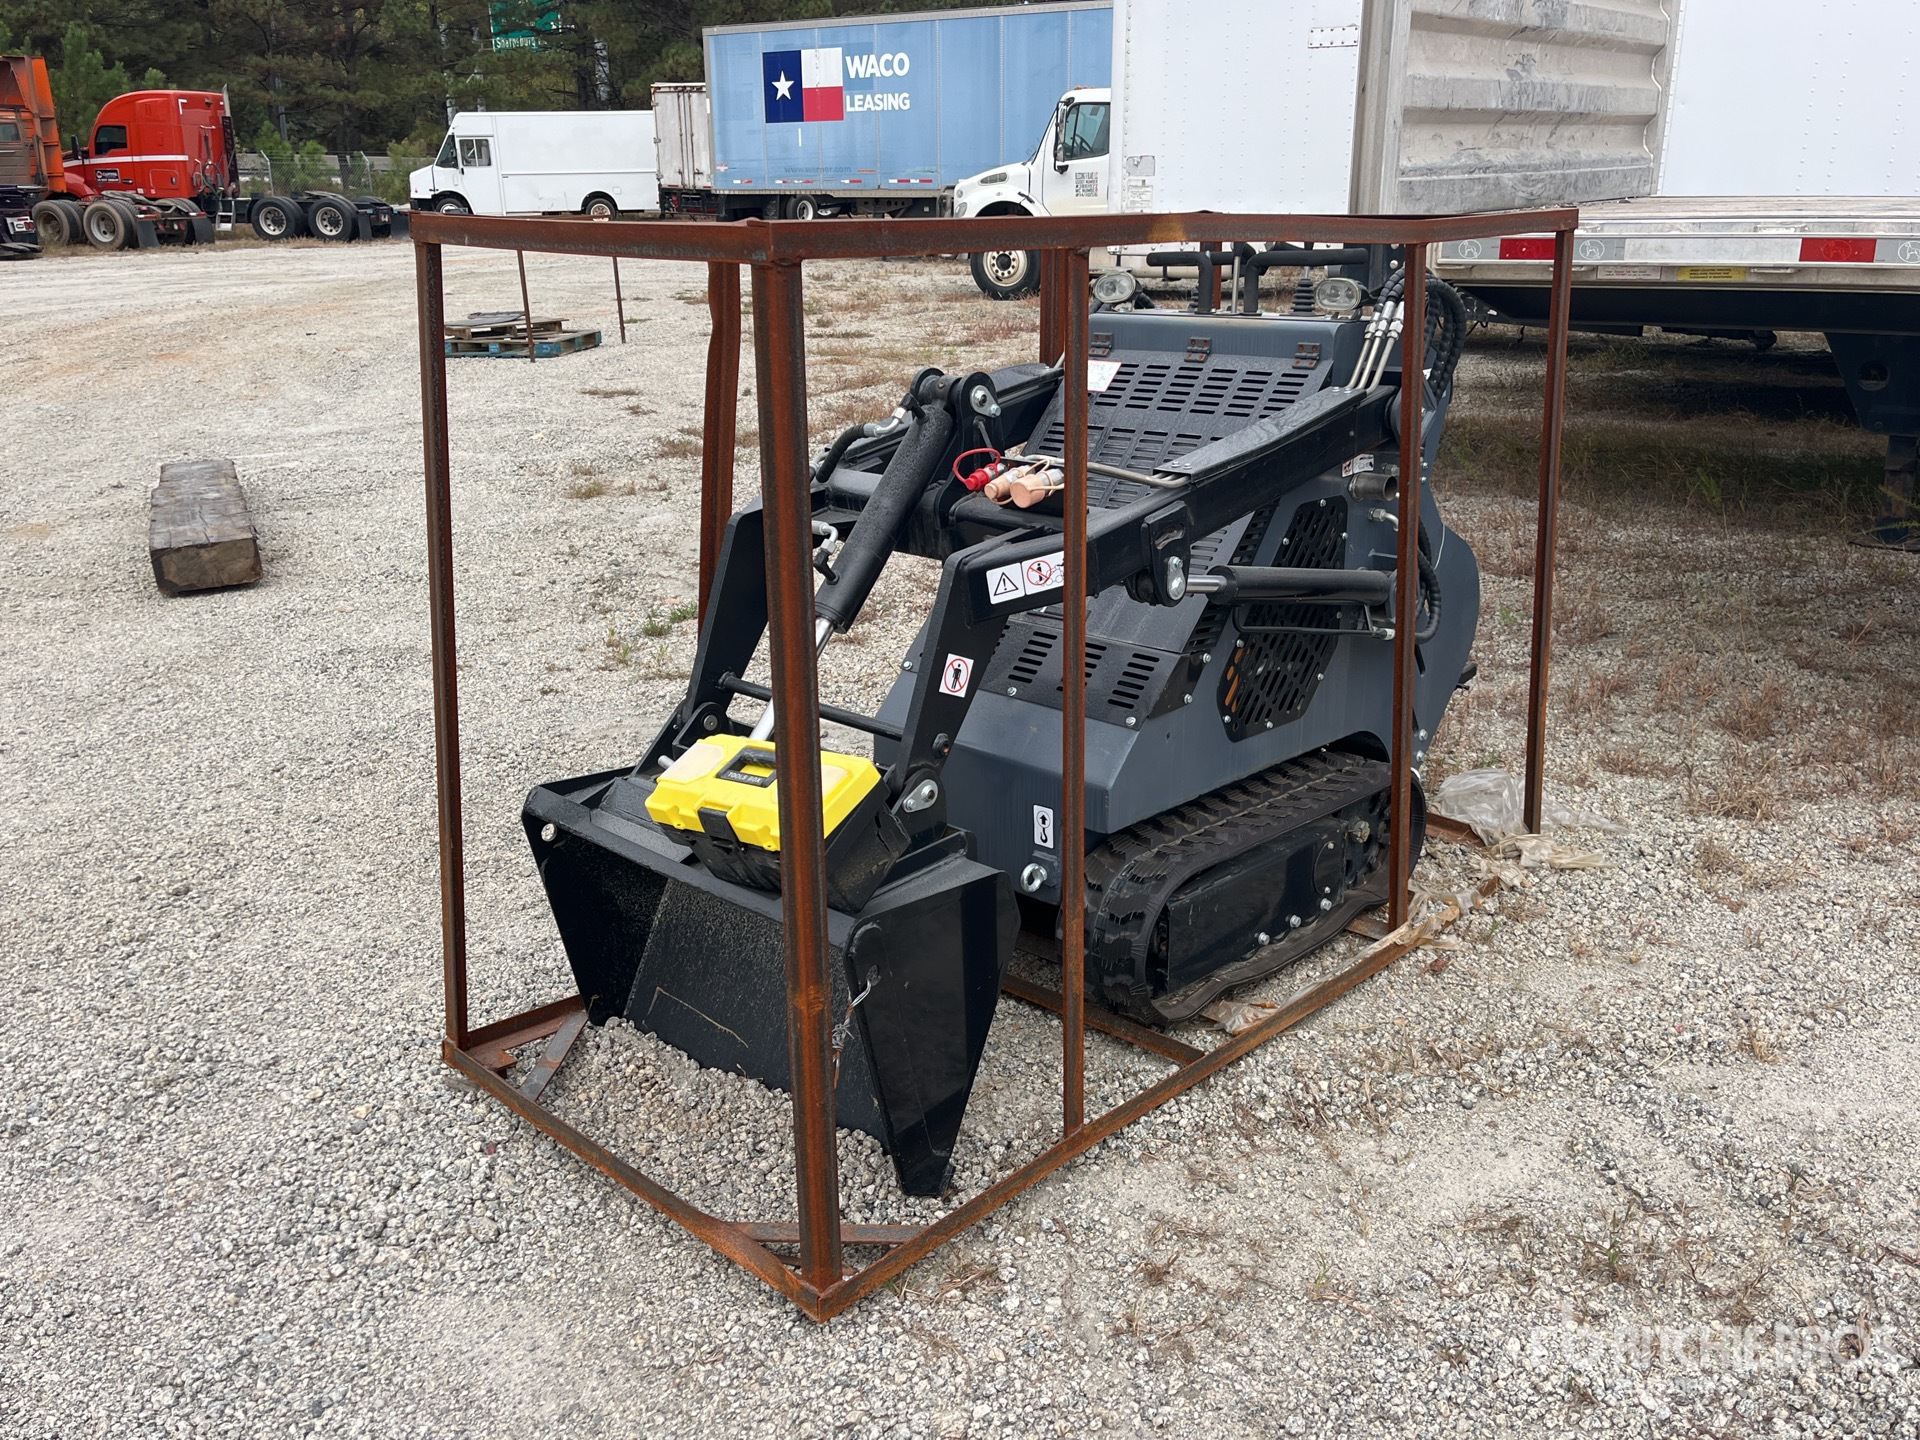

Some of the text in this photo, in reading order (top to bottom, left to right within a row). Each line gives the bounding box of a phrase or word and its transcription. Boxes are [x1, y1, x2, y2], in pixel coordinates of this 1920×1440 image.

[845, 52, 910, 79] WACO
[846, 92, 911, 112] LEASING
[728, 772, 747, 780] TOOLS
